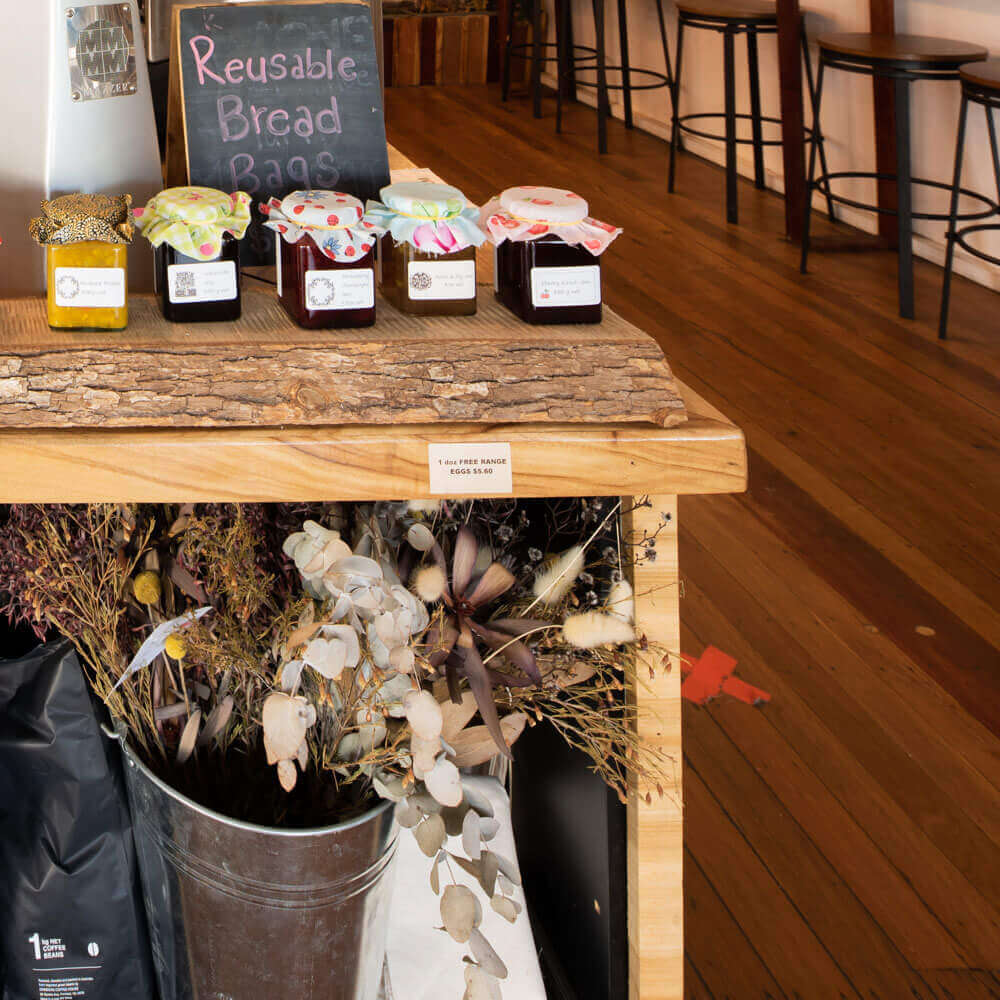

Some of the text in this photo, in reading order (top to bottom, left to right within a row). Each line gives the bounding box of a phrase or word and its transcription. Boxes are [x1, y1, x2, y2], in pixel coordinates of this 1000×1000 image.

[189, 34, 358, 85] Reusable
[216, 94, 343, 142] Bread
[229, 151, 340, 195] Bags
[473, 467, 493, 475] $5.60
[28, 932, 42, 960] 1
[42, 944, 66, 952] COFFEE
[43, 951, 65, 960] BEANS
